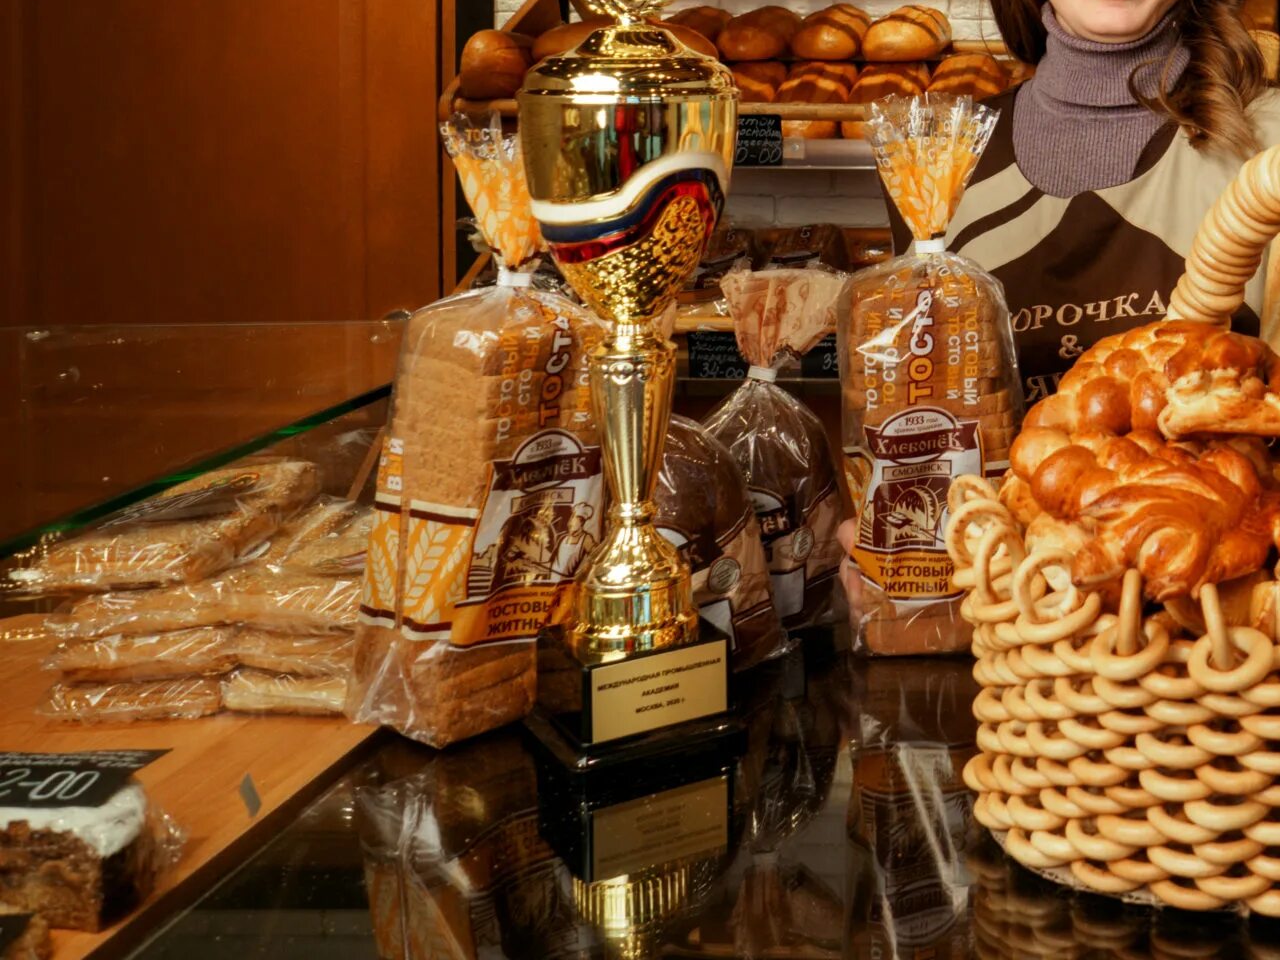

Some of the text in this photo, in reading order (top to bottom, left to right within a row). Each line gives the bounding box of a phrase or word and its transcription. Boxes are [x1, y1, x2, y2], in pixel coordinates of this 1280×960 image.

[1010, 289, 1168, 332] ОРОЧКА
[1058, 334, 1084, 360] &
[904, 415, 925, 426] 1933
[891, 463, 944, 477] СМОЛЕНСК
[879, 561, 956, 580] ТОСТОВЫЙ
[883, 578, 950, 596] ЖИТНЫЙ
[597, 657, 722, 692] МЕЖДУНАРОДНАЯ ПРОМЫШЛЕННАЯ
[641, 682, 680, 698] АКАДЕМИЯ
